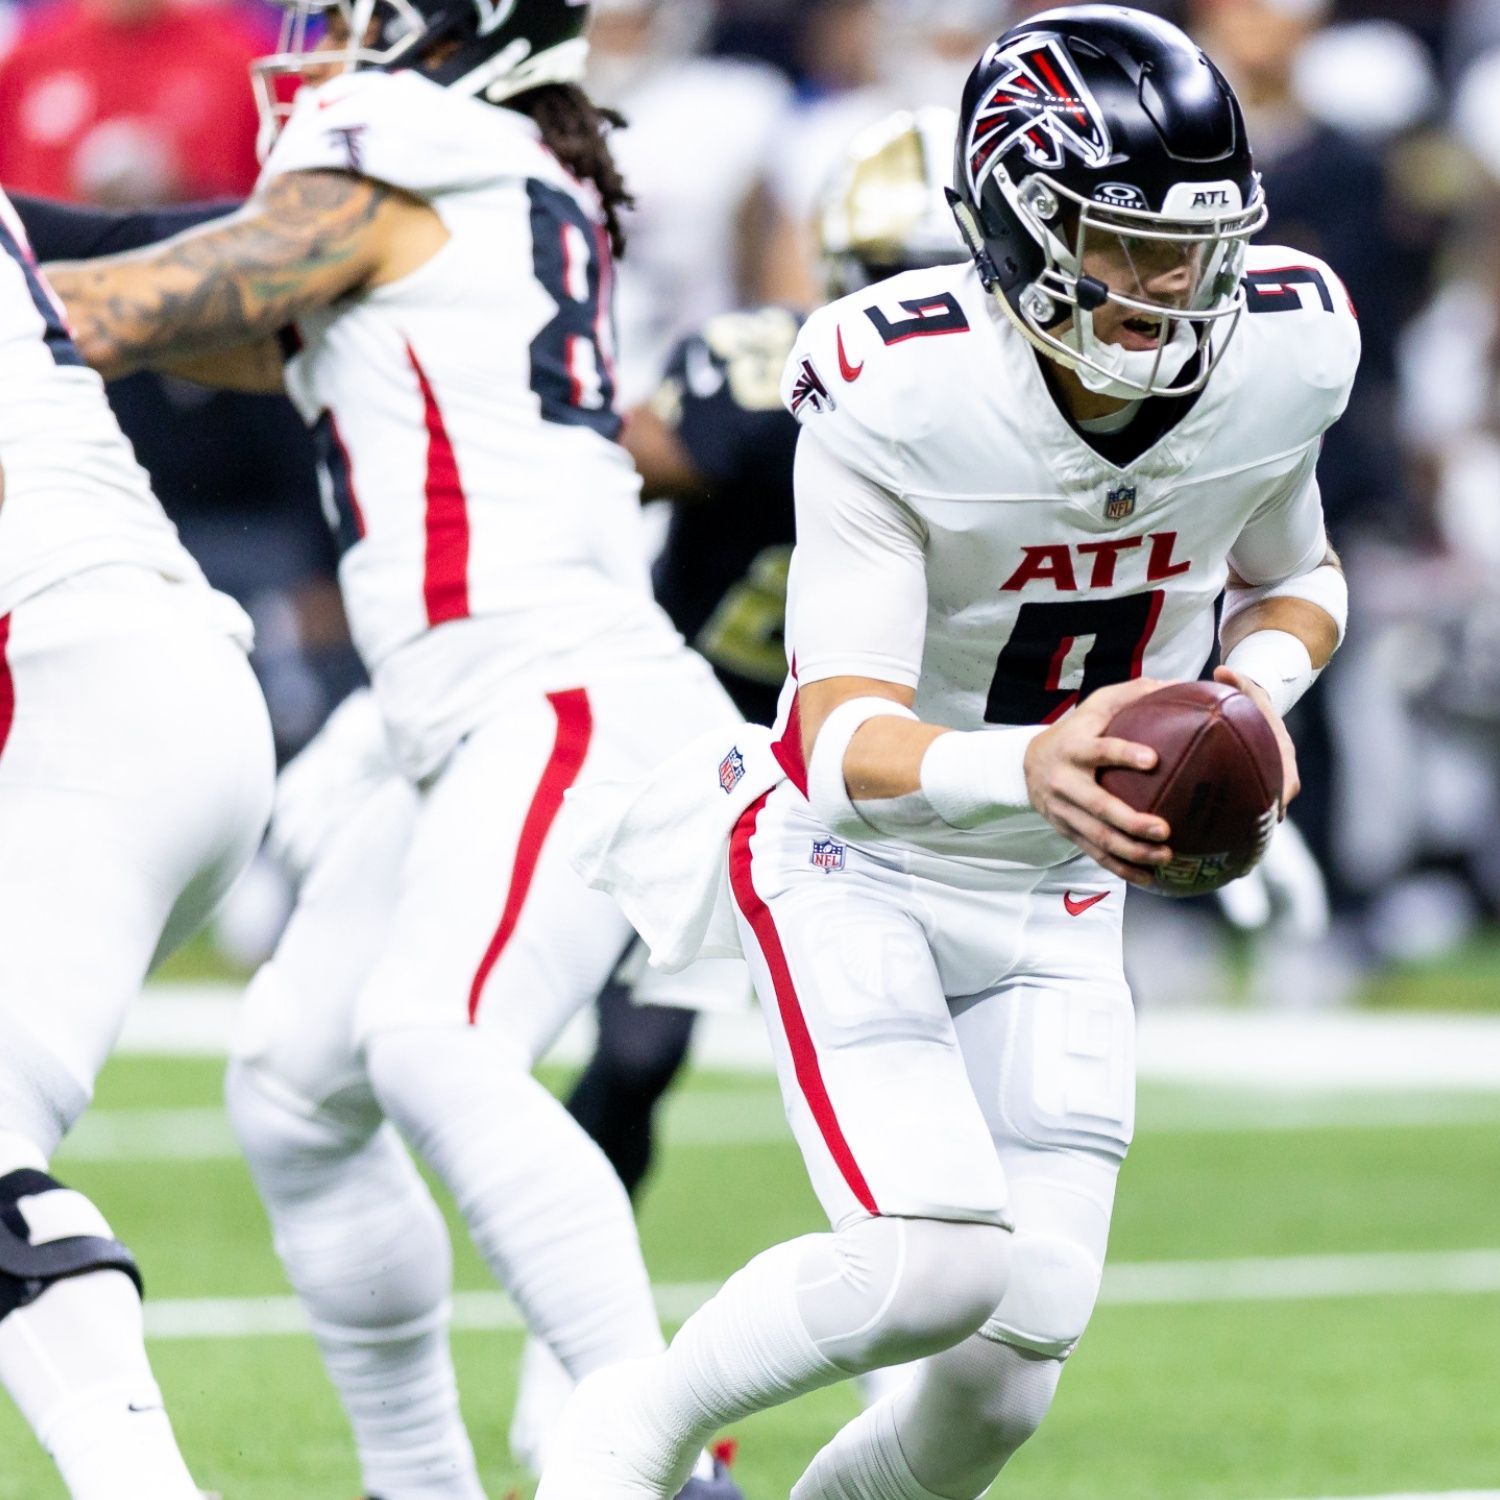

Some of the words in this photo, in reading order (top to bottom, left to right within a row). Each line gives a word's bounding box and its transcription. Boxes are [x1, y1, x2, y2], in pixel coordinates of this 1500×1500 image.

[1094, 194, 1143, 209] OAKLEY
[1191, 190, 1229, 209] ATL
[1240, 265, 1334, 313] 9
[863, 292, 970, 346] 9
[1107, 500, 1133, 518] NFL
[999, 531, 1191, 592] ATL
[983, 589, 1165, 725] 9
[721, 758, 736, 791] NFL
[815, 853, 840, 867] NFL
